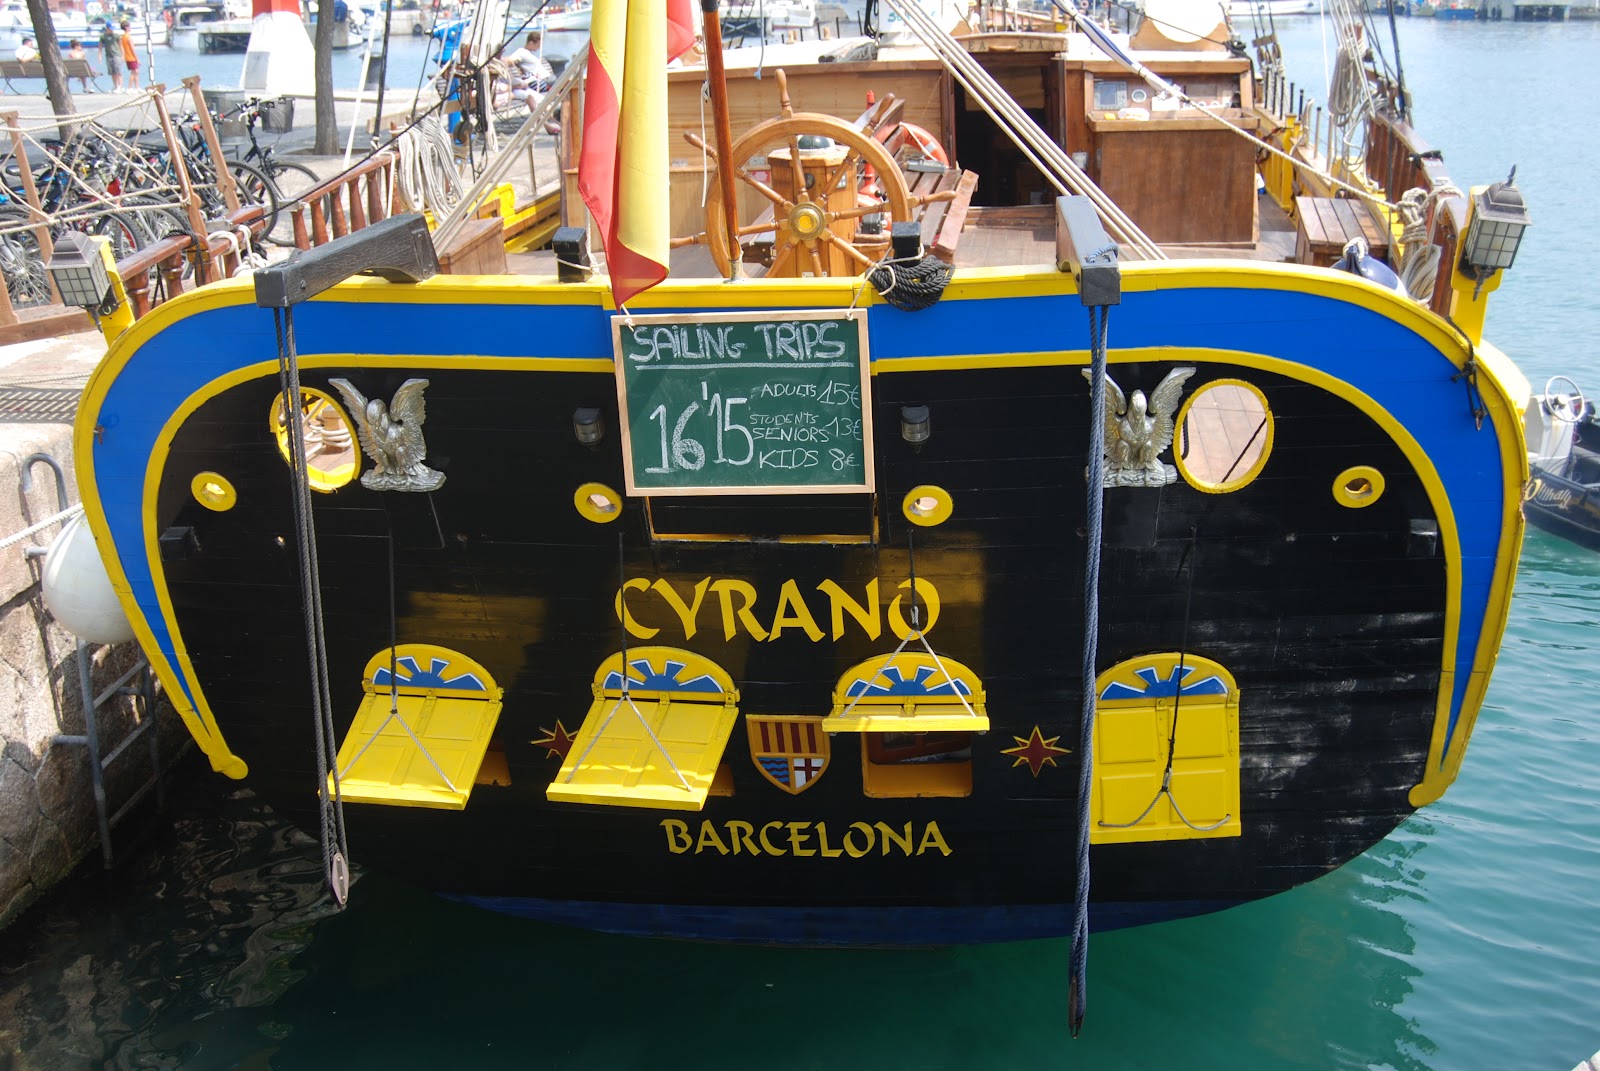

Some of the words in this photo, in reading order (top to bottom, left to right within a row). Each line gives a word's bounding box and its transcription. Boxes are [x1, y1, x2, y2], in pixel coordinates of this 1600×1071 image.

[761, 383, 817, 398] ADULTS
[816, 380, 860, 409] 15€
[749, 411, 819, 426] STUDENTS
[752, 427, 829, 443] SENIORS
[825, 416, 862, 441] 13€
[760, 447, 819, 470] KIDS
[829, 448, 859, 471] 8€
[614, 576, 941, 643] CYRANO
[659, 818, 953, 859] BARCELONA
